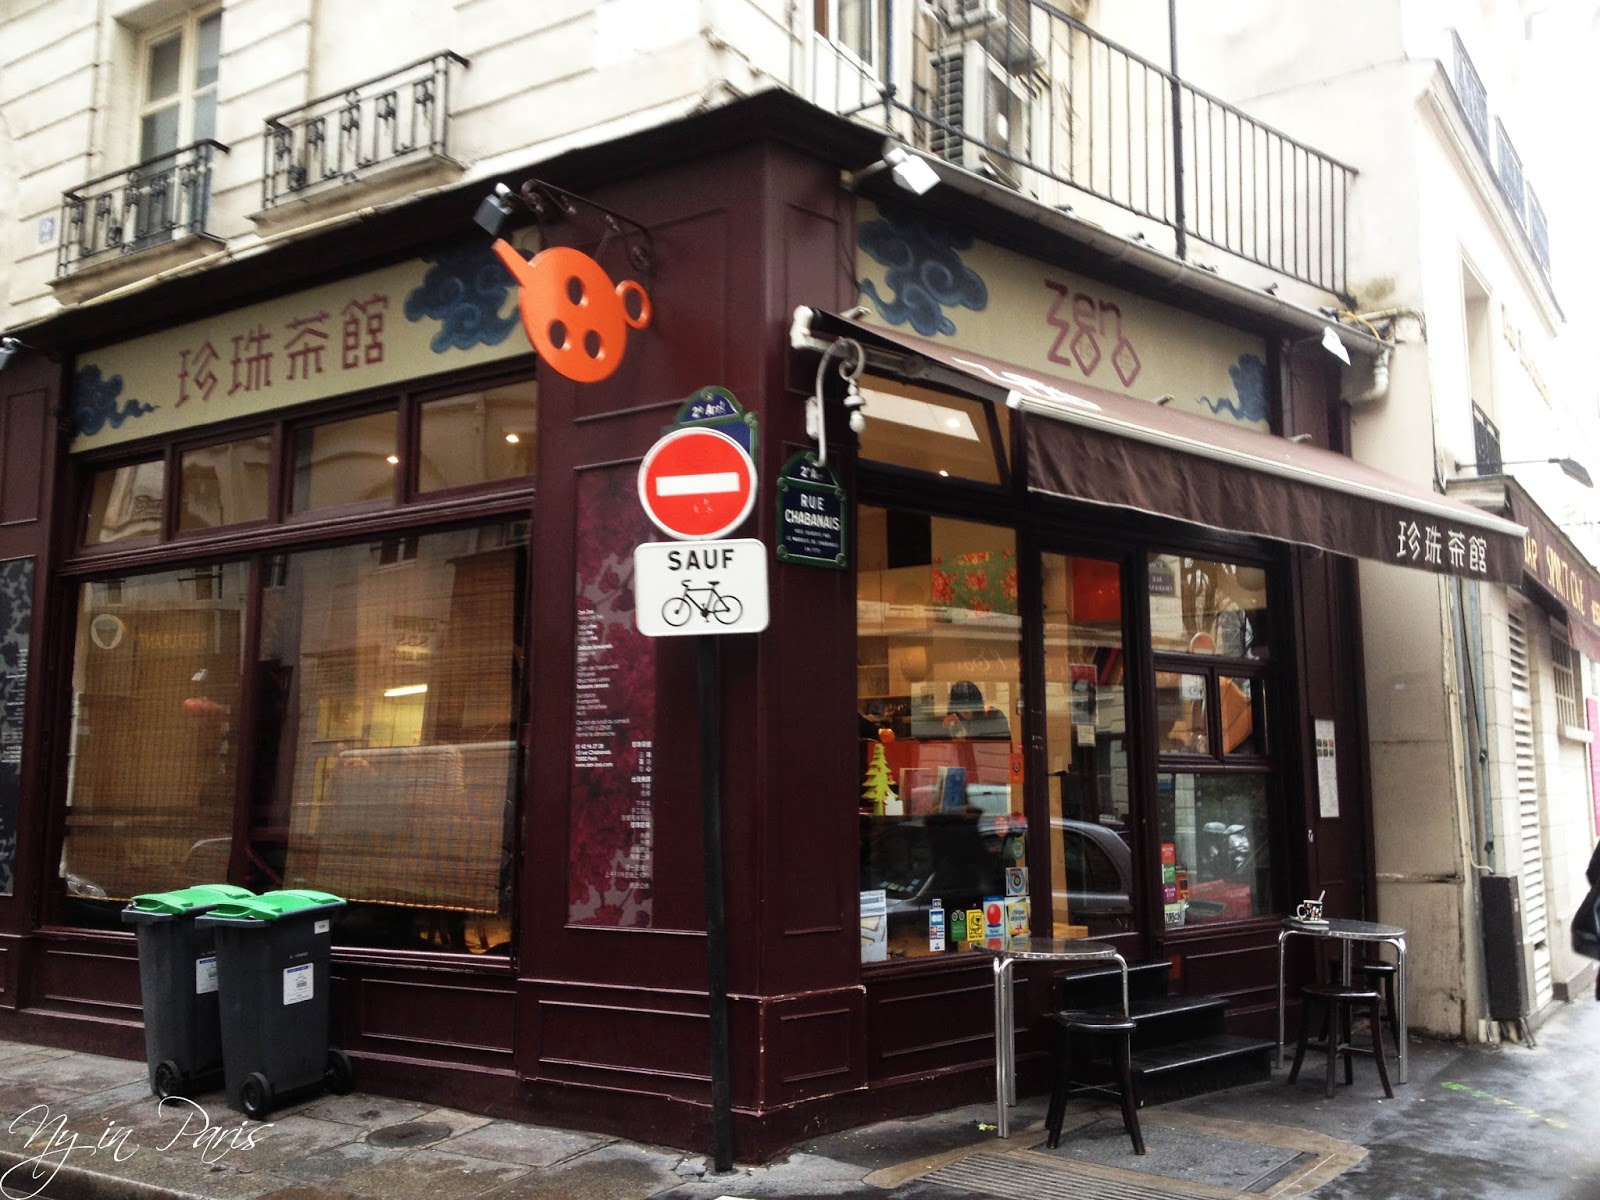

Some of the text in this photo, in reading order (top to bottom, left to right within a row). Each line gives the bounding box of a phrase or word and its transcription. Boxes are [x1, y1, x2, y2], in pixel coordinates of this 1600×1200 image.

[175, 293, 389, 409] 珍珠茶館
[801, 493, 825, 511] RUE
[784, 508, 841, 531] CHABANAIS
[1396, 520, 1487, 573] 珍珠茶館
[667, 548, 735, 571] SAUF
